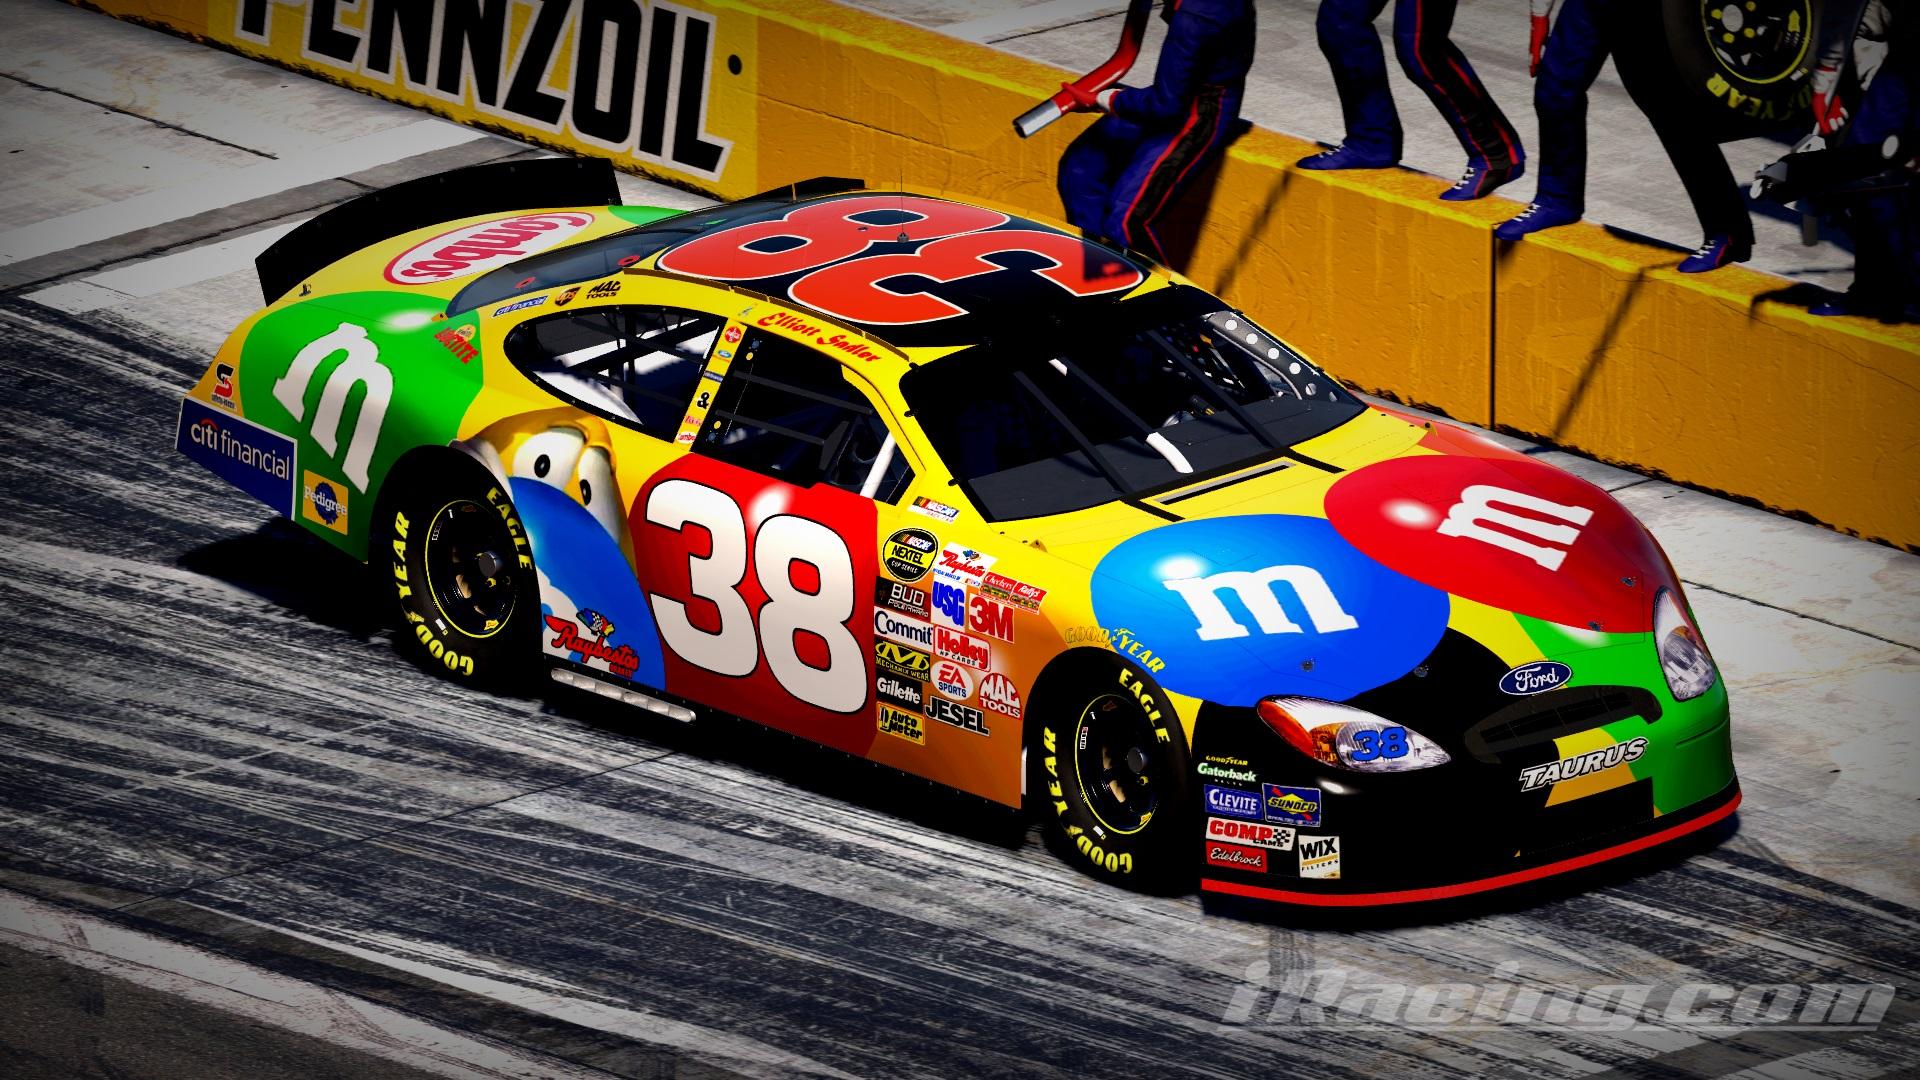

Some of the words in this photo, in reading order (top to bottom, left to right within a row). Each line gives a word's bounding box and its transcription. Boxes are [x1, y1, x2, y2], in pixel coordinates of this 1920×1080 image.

[400, 215, 587, 278] Combos
[657, 195, 1144, 326] 38
[757, 312, 821, 337] Elliott
[816, 334, 882, 362] Sadler
[190, 419, 219, 451] citi
[221, 431, 290, 480] financial
[303, 485, 348, 517] Pedigree
[487, 487, 532, 571] EAGLE
[908, 533, 932, 550] NASCAR
[891, 544, 924, 565] NEXTEL
[392, 511, 475, 676] GOODYEAR
[646, 478, 868, 714] 38
[891, 584, 925, 606] BUD
[931, 581, 965, 627] USG
[1163, 565, 1359, 641] m
[874, 610, 933, 647] Commit
[969, 597, 1014, 642] 3M
[543, 614, 639, 672] Raybestos
[937, 628, 988, 669] Holley
[1064, 626, 1166, 674] GOODYEAR
[875, 655, 909, 676] MECHANIX
[910, 669, 929, 682] WEAR
[938, 664, 966, 688] EA
[1514, 667, 1562, 691] Ford
[876, 677, 921, 705] Gillette
[938, 682, 967, 698] SPORTS
[979, 673, 1021, 708] MAC
[1118, 668, 1170, 743] EAGLE
[890, 710, 918, 727] Auto
[925, 696, 990, 736] JESEL
[979, 697, 1021, 719] TOOLS
[888, 722, 923, 739] Meter
[1352, 726, 1410, 762] 38
[1197, 762, 1257, 783] Gatorback
[1205, 755, 1249, 766] GOODYEAR
[1519, 737, 1650, 793] TAURUS
[1044, 726, 1133, 874] GOODYEAR
[1209, 788, 1257, 811] CLEVITE
[1268, 796, 1317, 813] SUNOCO
[1209, 819, 1273, 841] COMP
[1252, 838, 1284, 848] CAMS
[1210, 847, 1263, 868] Edelbrock
[1300, 837, 1337, 860] WIX
[1301, 858, 1339, 871] FILTERS
